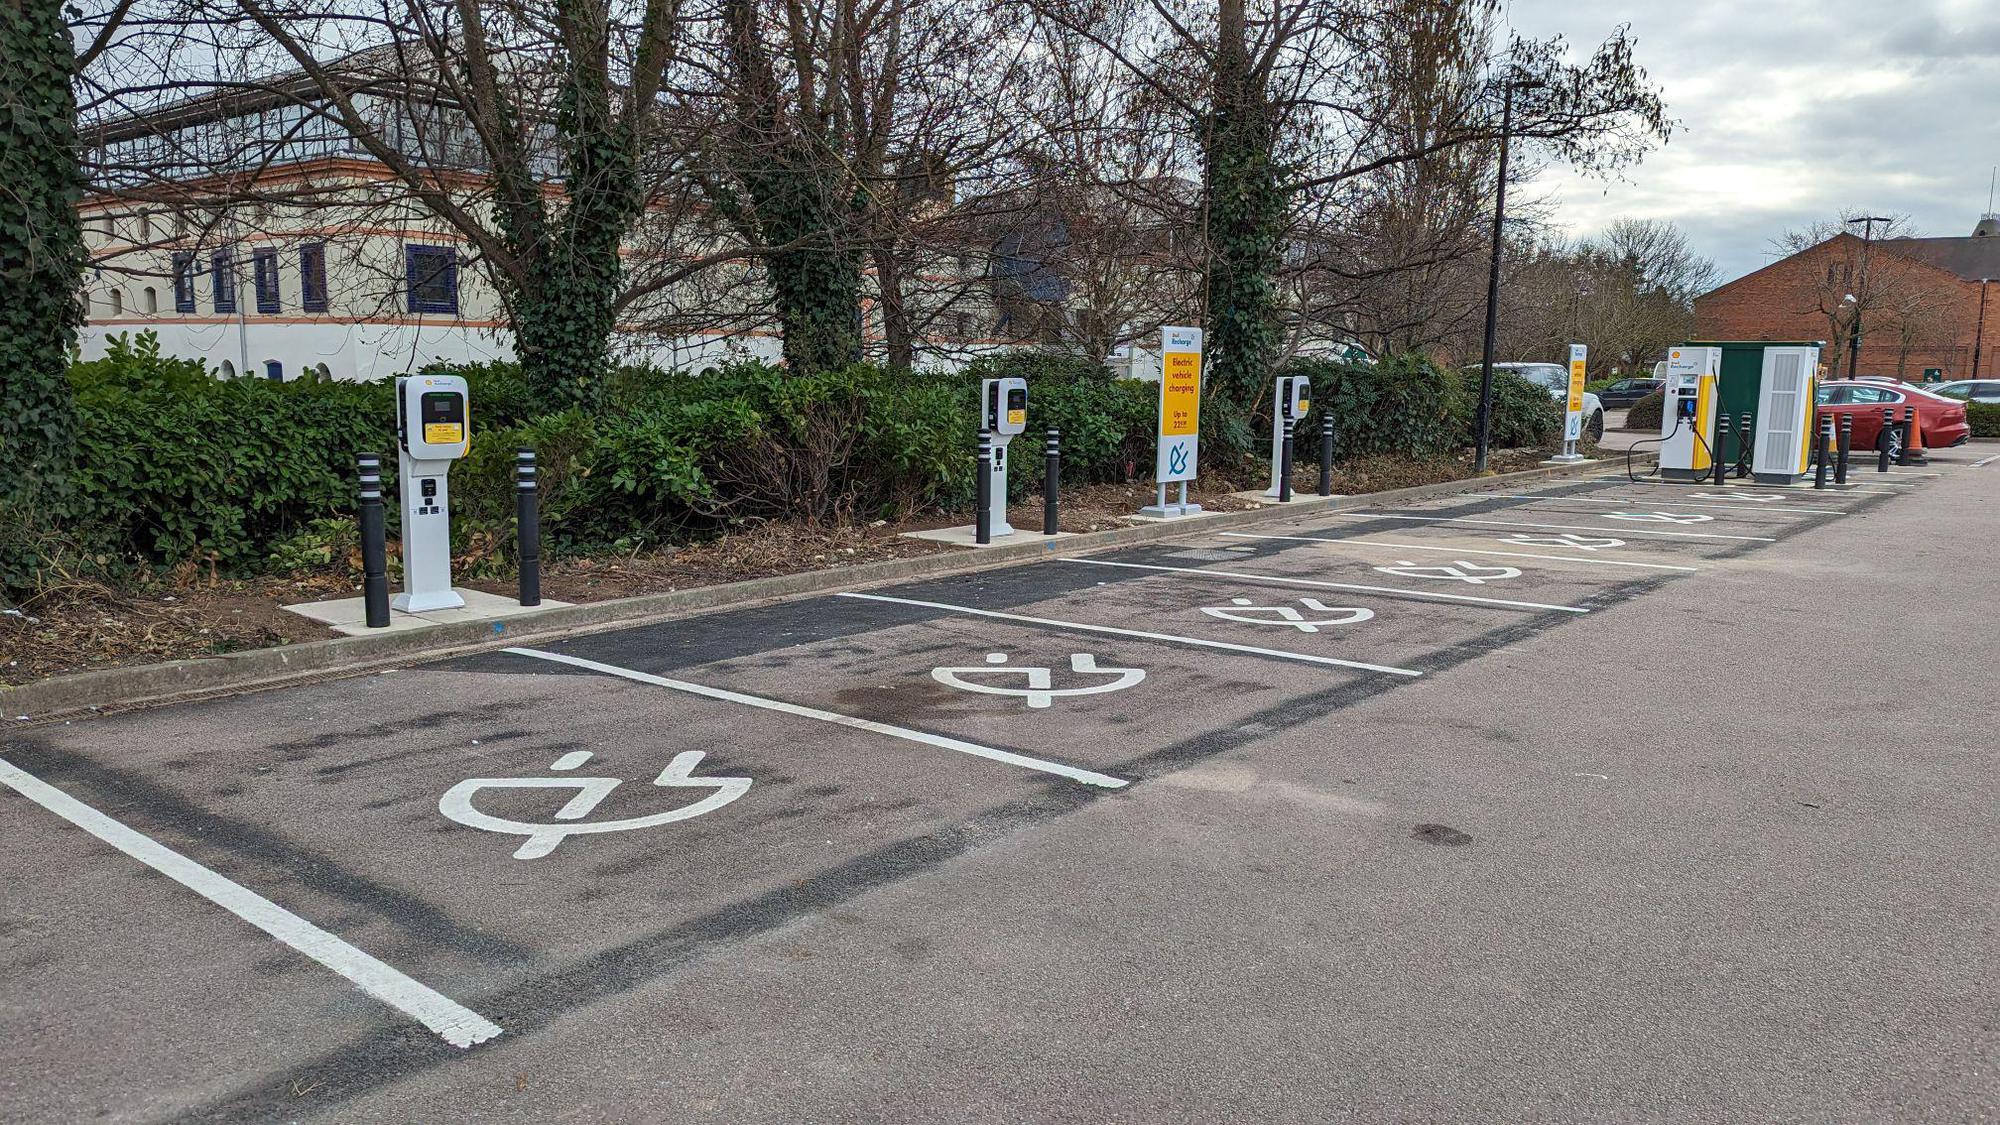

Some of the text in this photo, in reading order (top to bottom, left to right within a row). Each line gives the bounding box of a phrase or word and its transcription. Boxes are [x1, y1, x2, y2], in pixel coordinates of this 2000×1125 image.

[1172, 358, 1192, 366] Electric
[1172, 370, 1192, 379] vehicle
[1168, 383, 1194, 393] charging
[1174, 410, 1181, 419] Up
